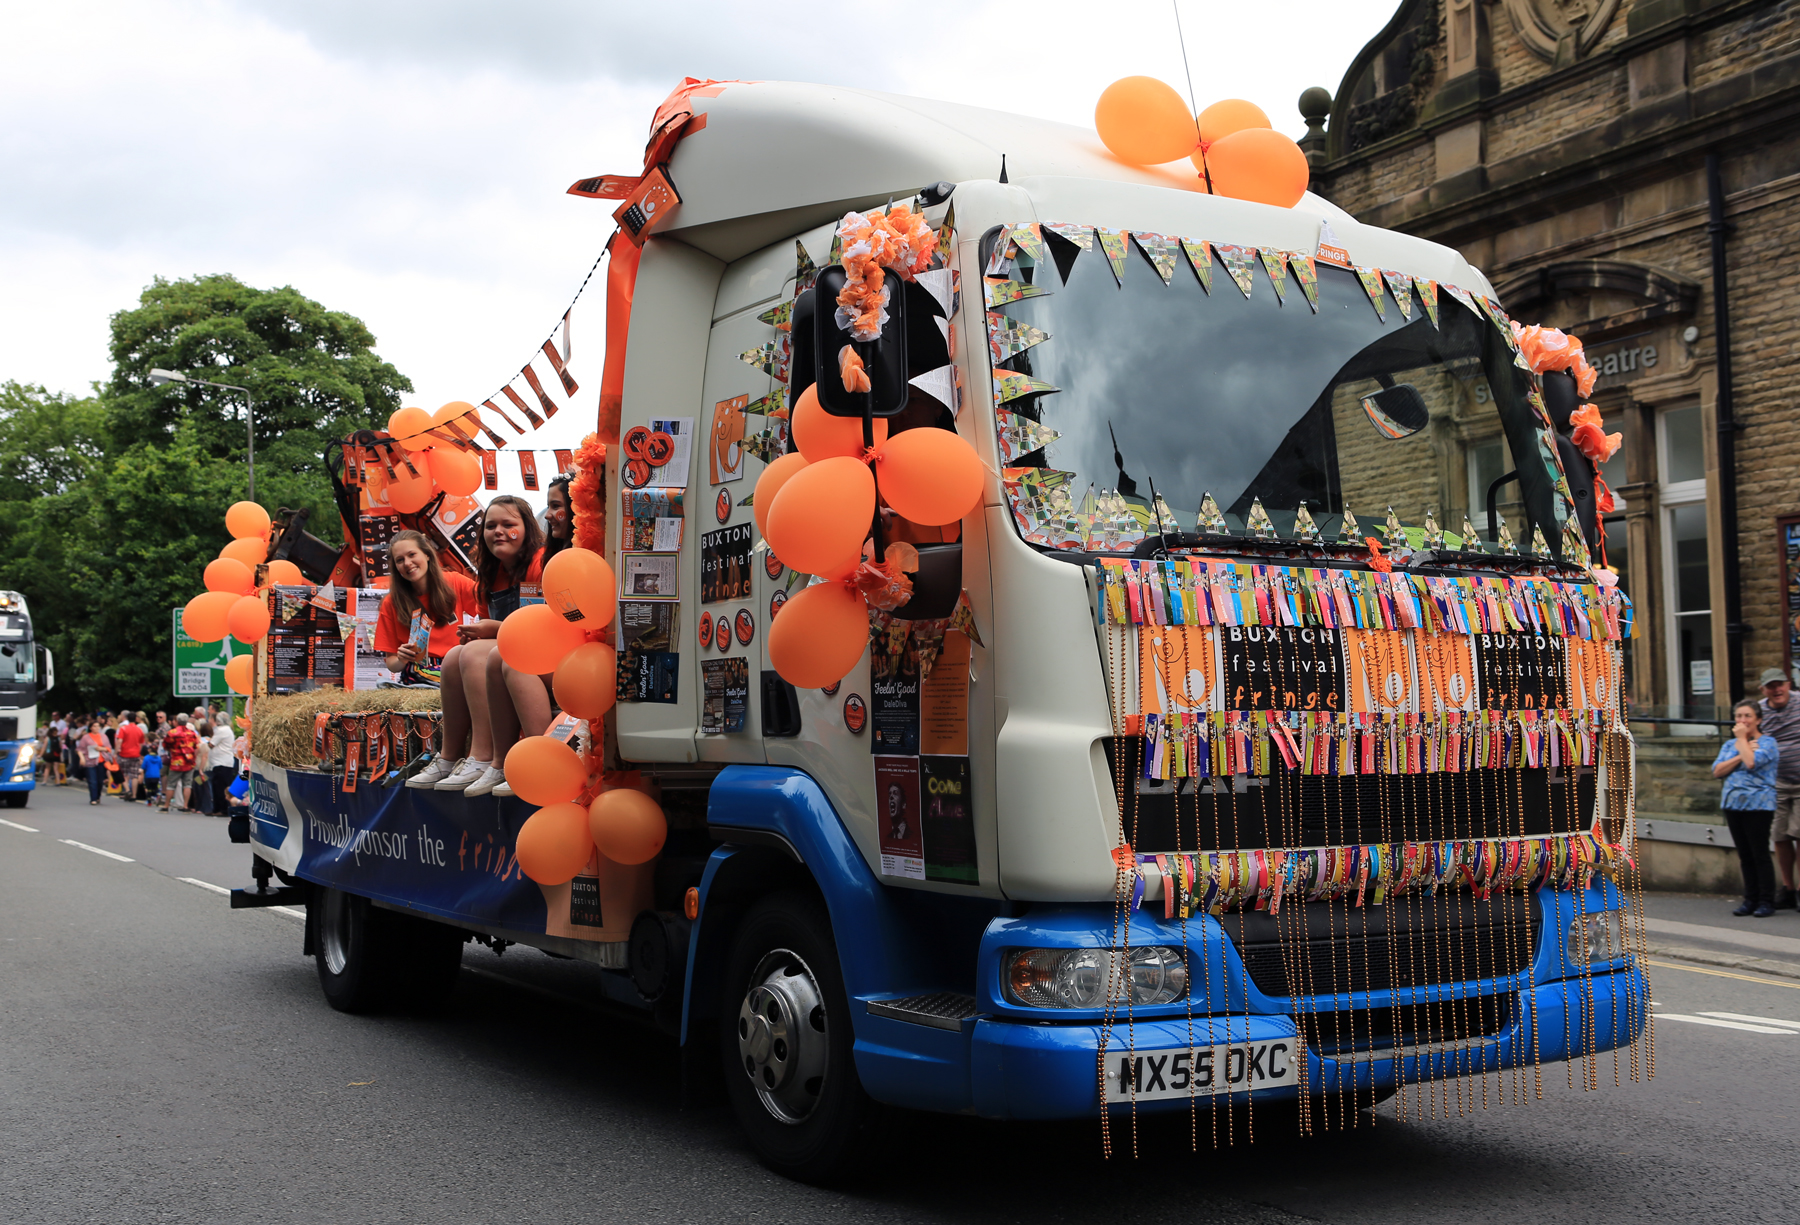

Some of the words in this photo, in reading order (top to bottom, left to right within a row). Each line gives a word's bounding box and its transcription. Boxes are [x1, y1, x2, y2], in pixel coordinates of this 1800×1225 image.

[702, 526, 750, 549] BUXTON
[702, 549, 750, 573] festival
[702, 579, 750, 601] fringe
[624, 604, 638, 626] ACTING
[638, 604, 652, 624] ALONE
[1230, 626, 1334, 644] BUXTON
[1482, 634, 1560, 650] BUXTON
[640, 654, 649, 675] Good
[1232, 654, 1336, 672] festival
[1485, 660, 1561, 676] festival
[874, 682, 896, 694] Feelin'
[896, 682, 916, 698] Good
[1234, 686, 1338, 710] fringe
[928, 777, 962, 794] Come
[259, 800, 278, 818] DERBY
[306, 810, 355, 862] Proudly
[351, 828, 408, 866] ponsor
[418, 824, 446, 867] the
[458, 830, 522, 882] fring
[572, 882, 597, 892] BUXTON
[572, 895, 598, 906] festival
[572, 910, 600, 922] fringe
[1120, 1051, 1214, 1094] MX55
